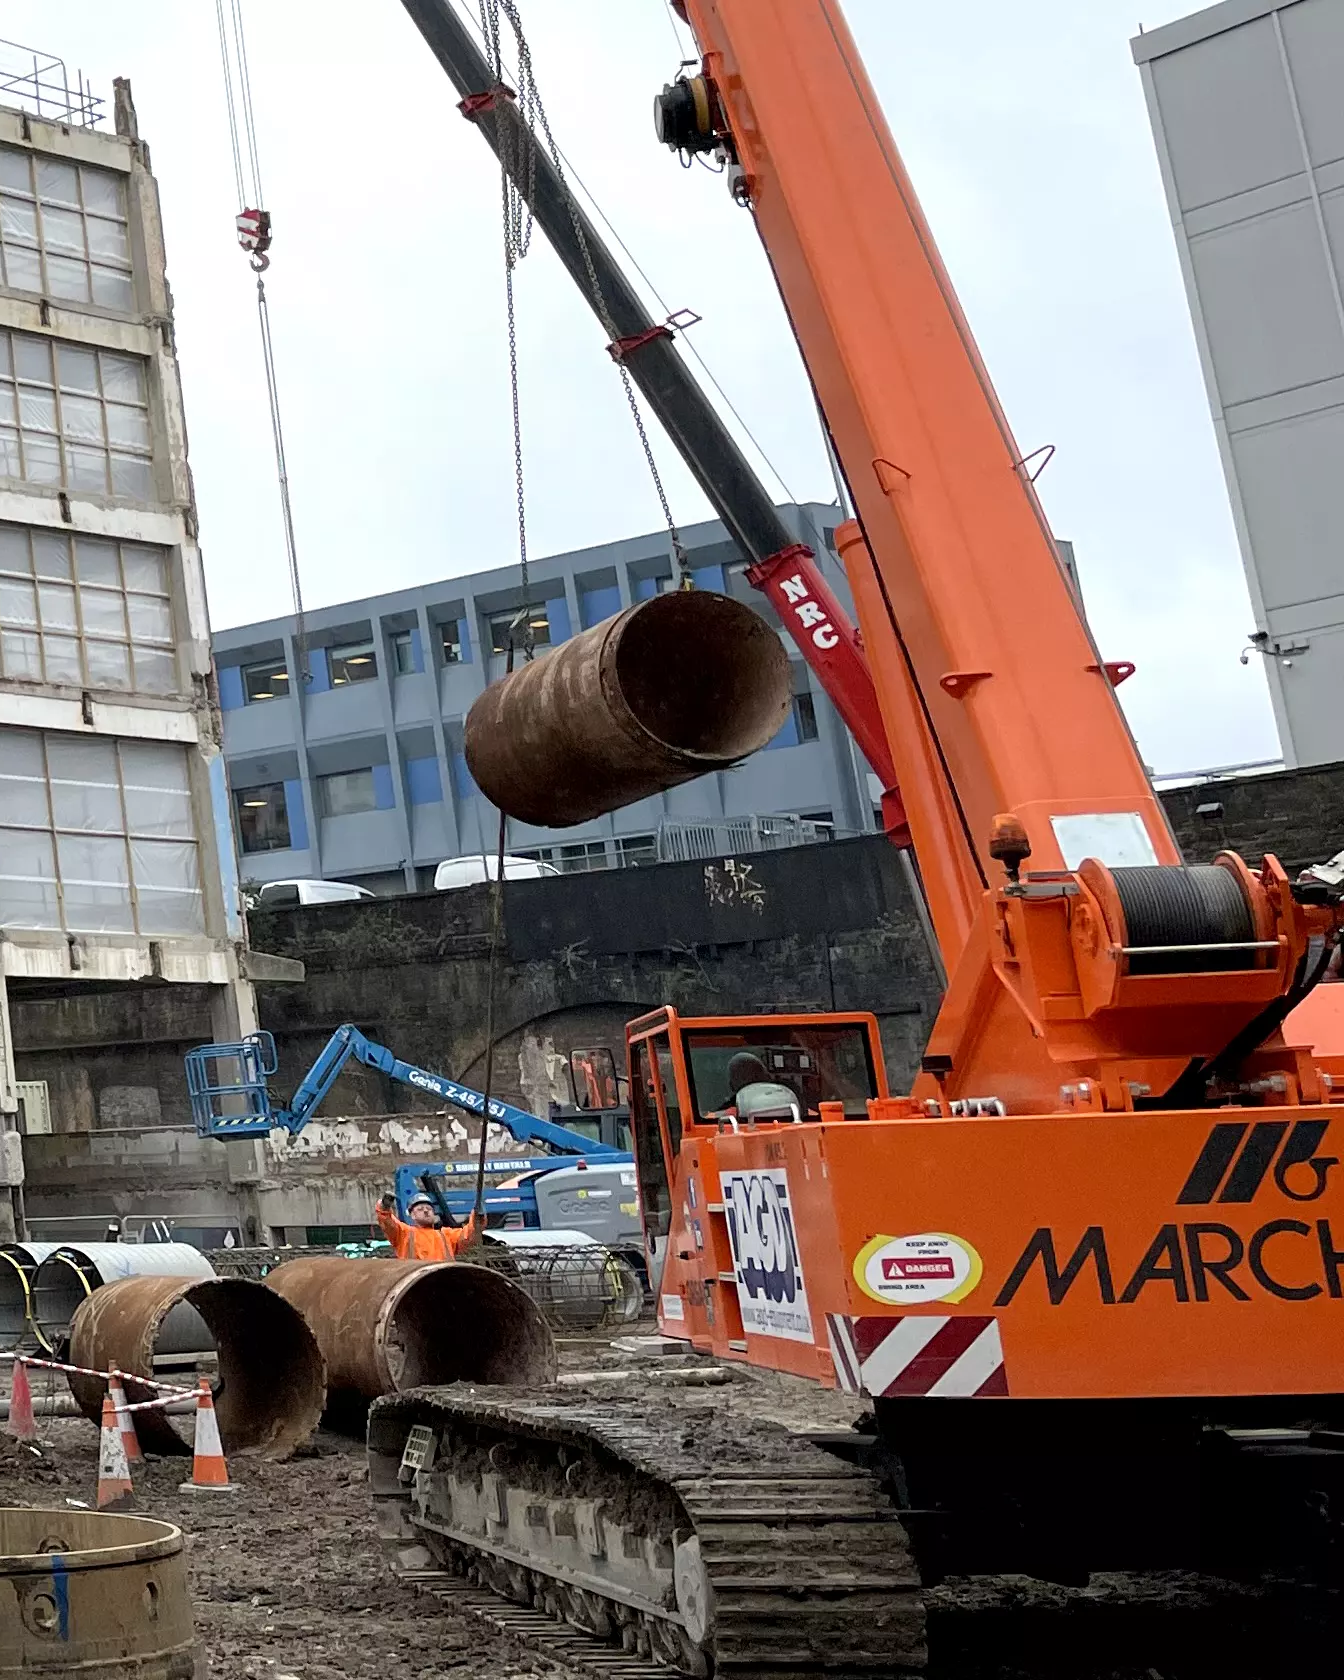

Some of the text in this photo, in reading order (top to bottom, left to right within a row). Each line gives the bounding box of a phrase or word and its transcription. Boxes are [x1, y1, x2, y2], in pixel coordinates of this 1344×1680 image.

[779, 573, 839, 649] NRC
[408, 1070, 507, 1118] Genie Z-45/5J
[905, 1263, 950, 1274] DANGER
[992, 1218, 1344, 1307] MARCH
